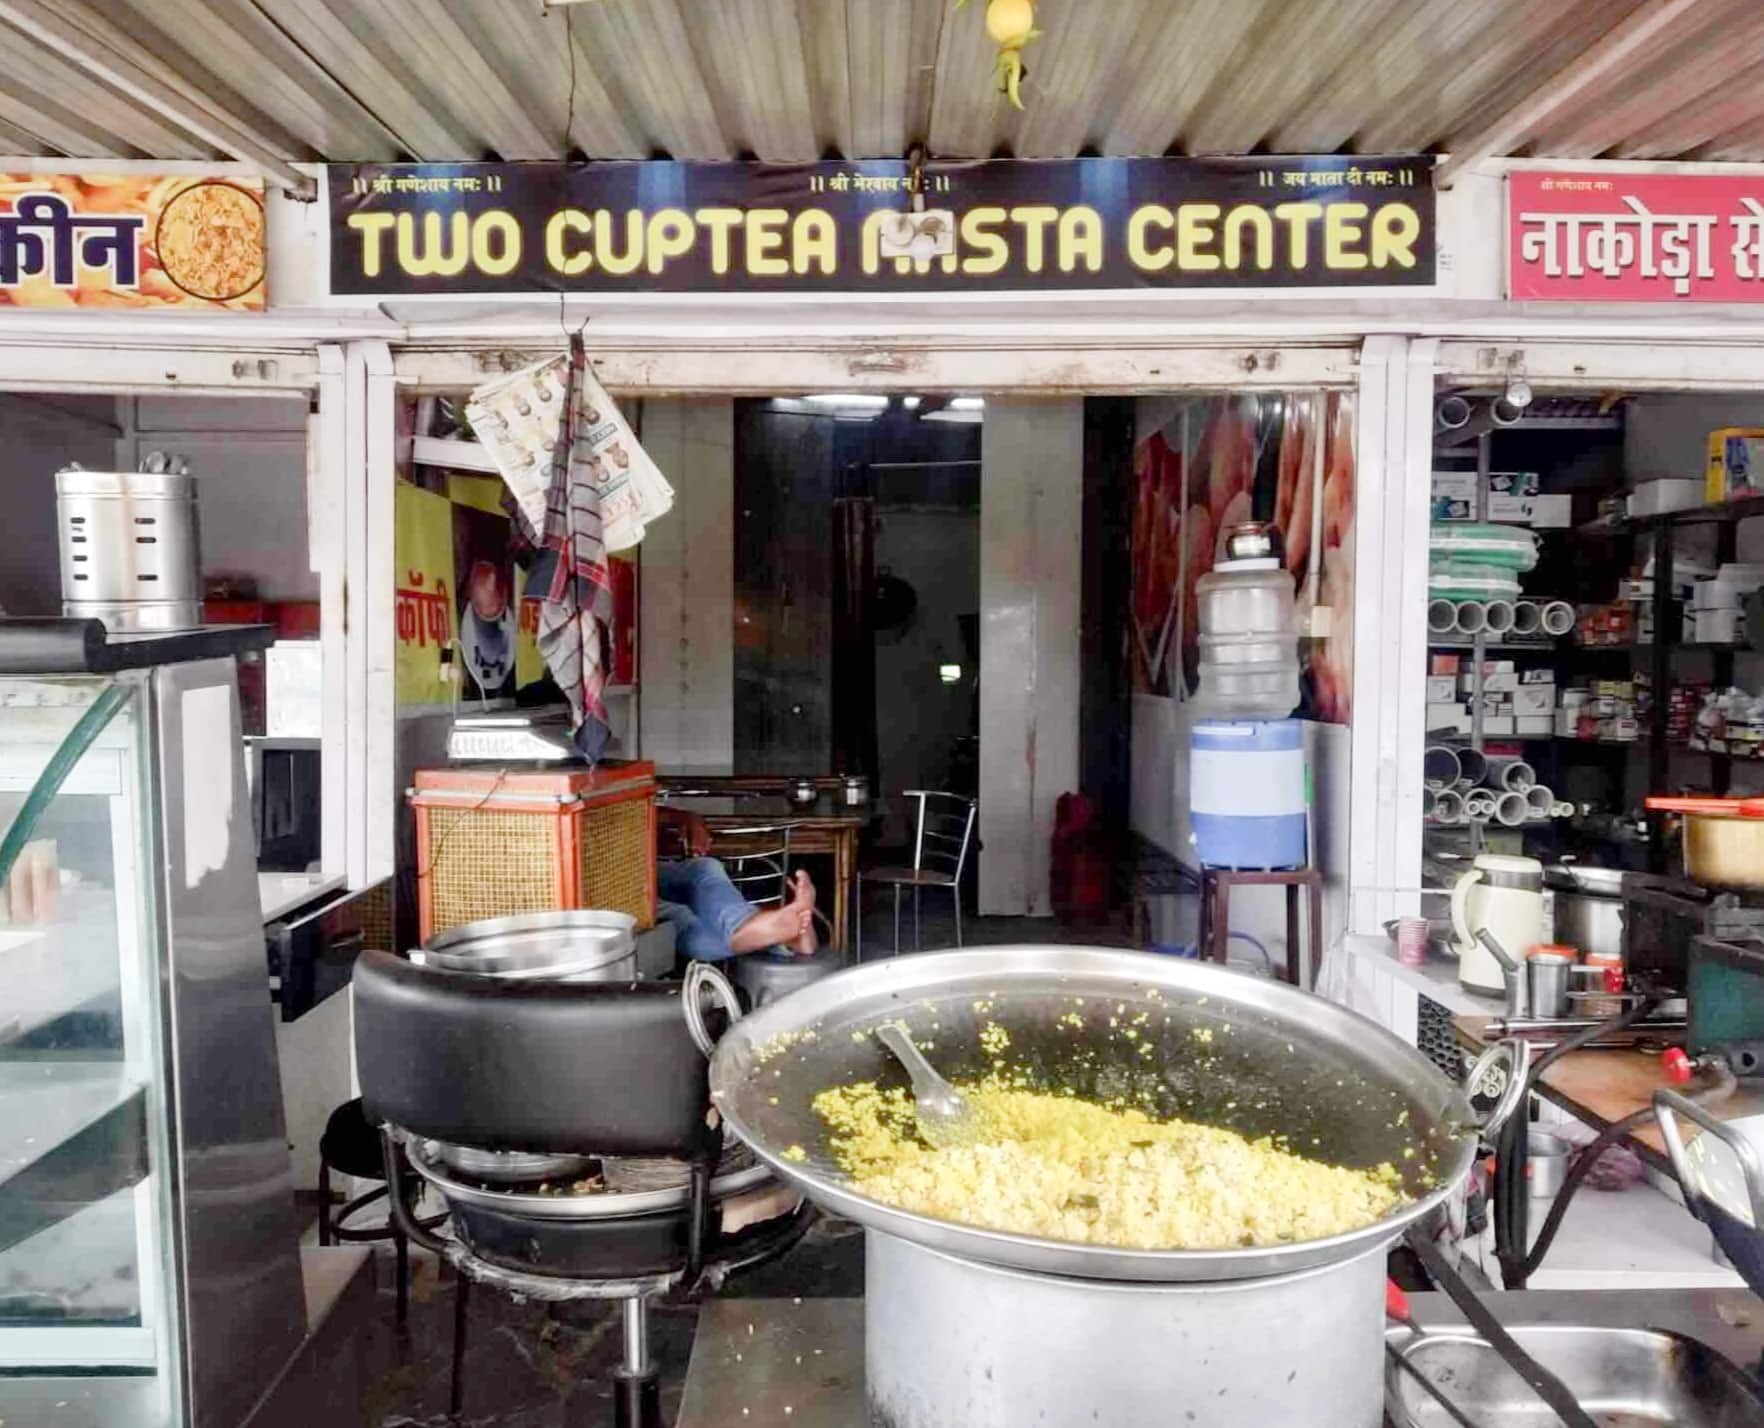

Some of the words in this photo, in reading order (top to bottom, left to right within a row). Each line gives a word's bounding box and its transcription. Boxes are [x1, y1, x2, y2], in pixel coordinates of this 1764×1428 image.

[373, 173, 393, 194] श्री
[396, 173, 450, 193] गणेशाय
[829, 172, 849, 192] श्री
[1282, 171, 1307, 187] जय
[347, 208, 521, 278] TWO
[545, 207, 837, 276] CUPTEA
[861, 206, 1103, 275] NSTA
[1127, 203, 1421, 271] CENTER
